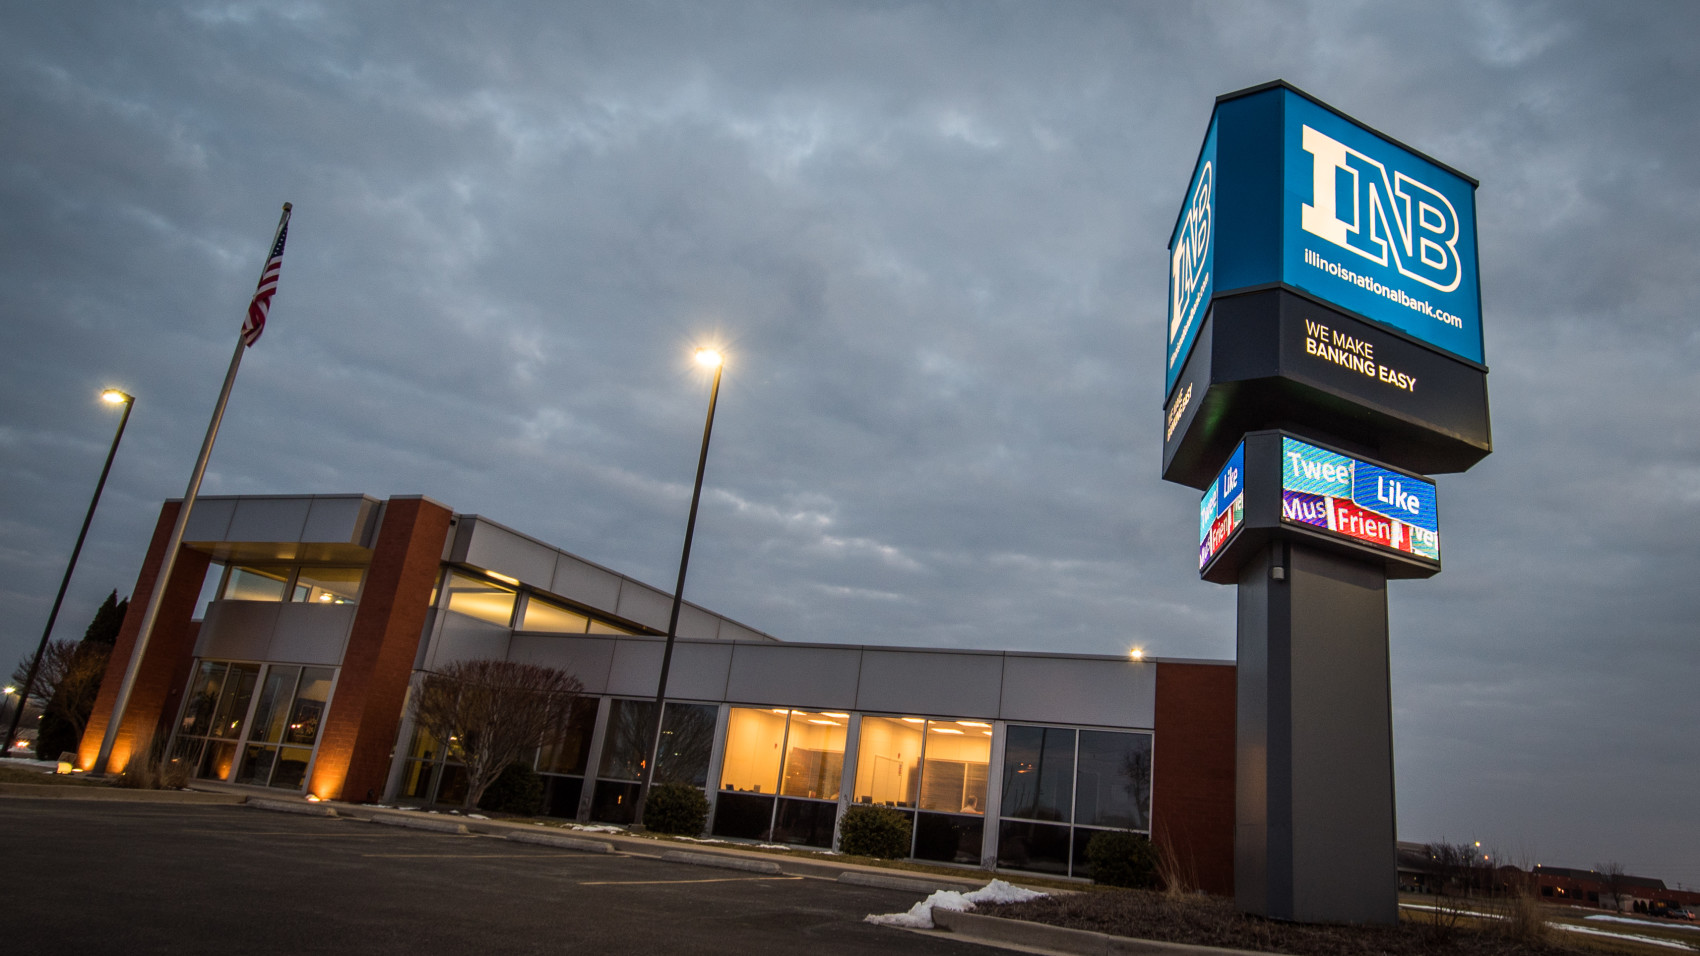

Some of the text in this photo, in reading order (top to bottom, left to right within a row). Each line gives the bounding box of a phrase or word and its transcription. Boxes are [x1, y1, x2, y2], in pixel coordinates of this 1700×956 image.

[1302, 124, 1462, 292] INB
[1170, 160, 1212, 344] INB
[1304, 248, 1463, 329] illinoisnationalbank.com
[1305, 319, 1374, 360] WE MAKE
[1306, 337, 1417, 392] BANKING EASY
[1224, 467, 1238, 498] Like
[1377, 475, 1420, 515] Like
